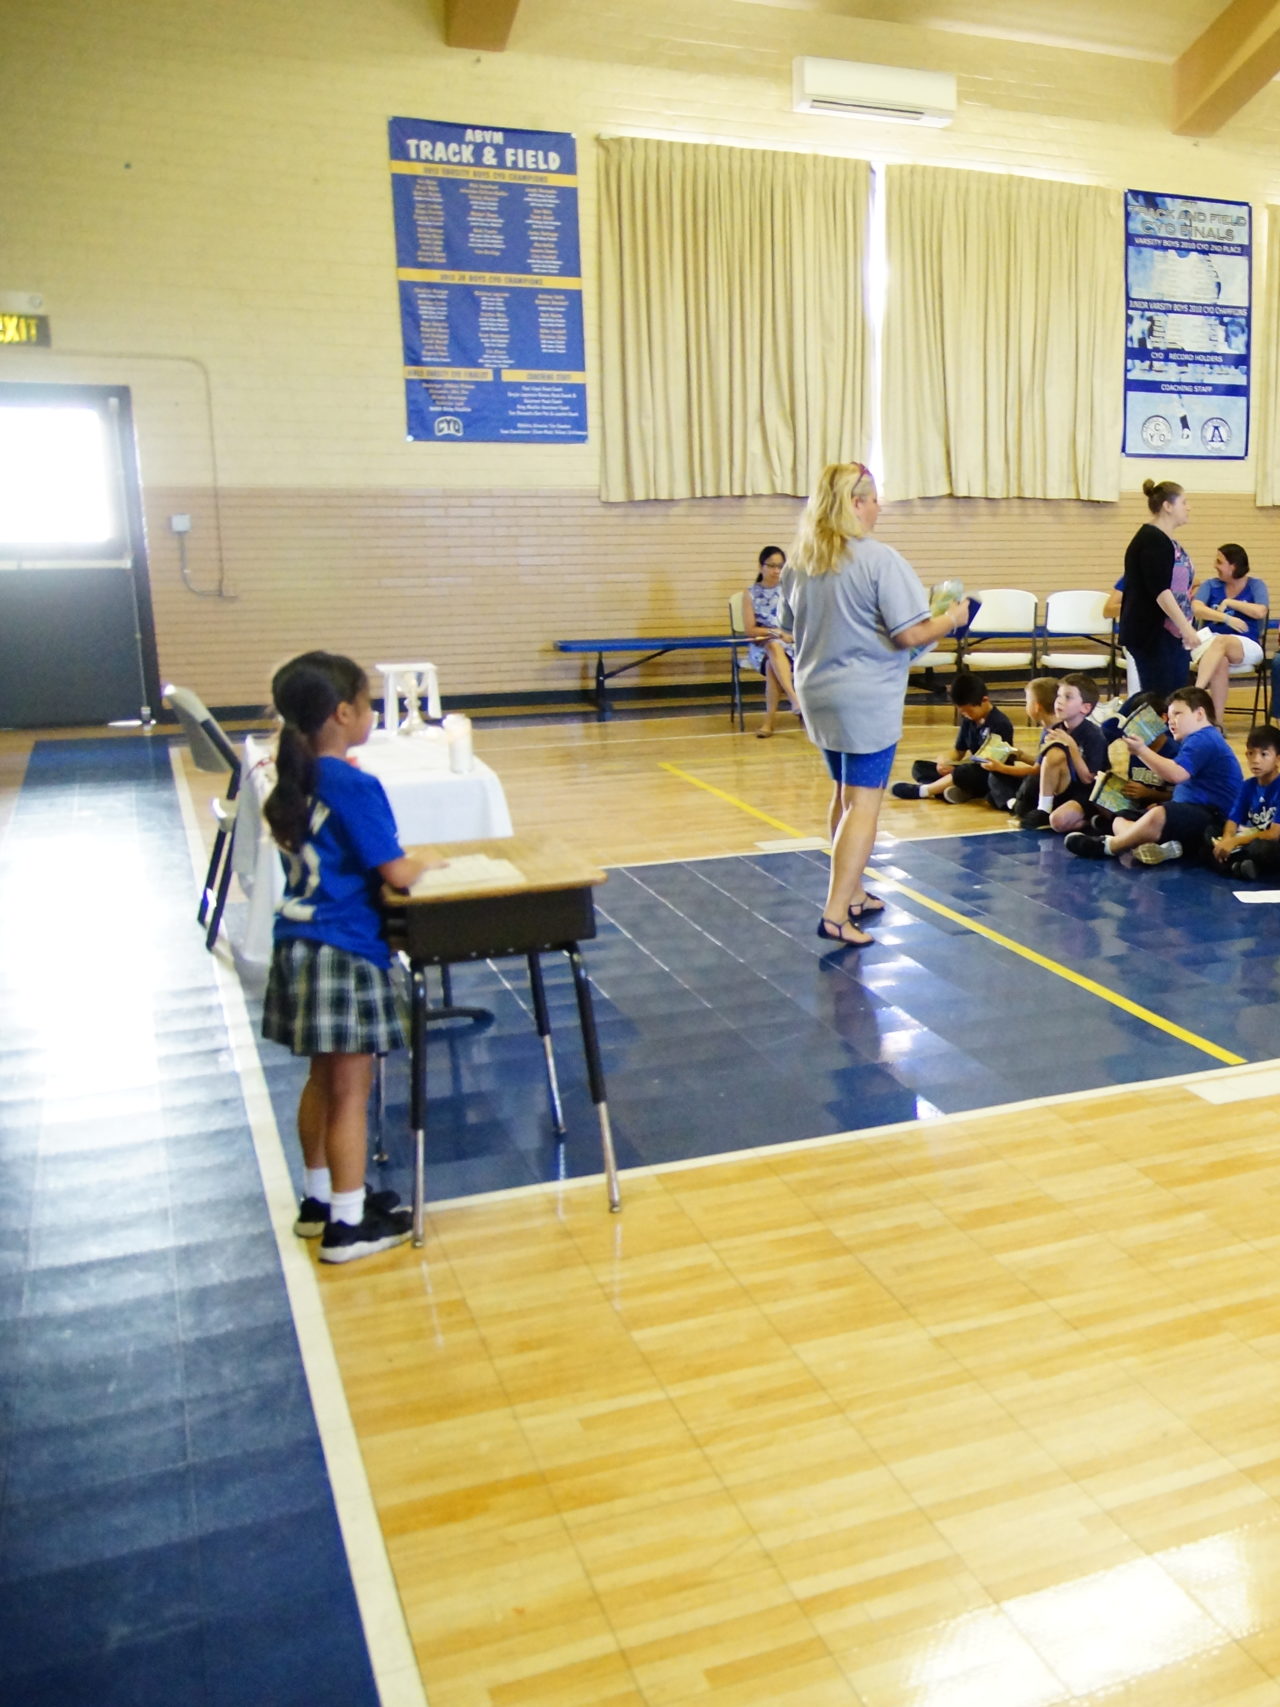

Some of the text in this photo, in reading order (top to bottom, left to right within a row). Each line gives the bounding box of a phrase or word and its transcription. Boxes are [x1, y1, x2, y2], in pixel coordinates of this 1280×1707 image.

[465, 129, 504, 144] ABVM
[406, 139, 561, 171] TRACK & FIELD
[1128, 206, 1247, 227] TRACK AND FIELD
[1180, 223, 1234, 242] FINALS
[1222, 246, 1242, 254] PLACE
[0, 315, 38, 344] XIT
[436, 419, 462, 434] CYO
